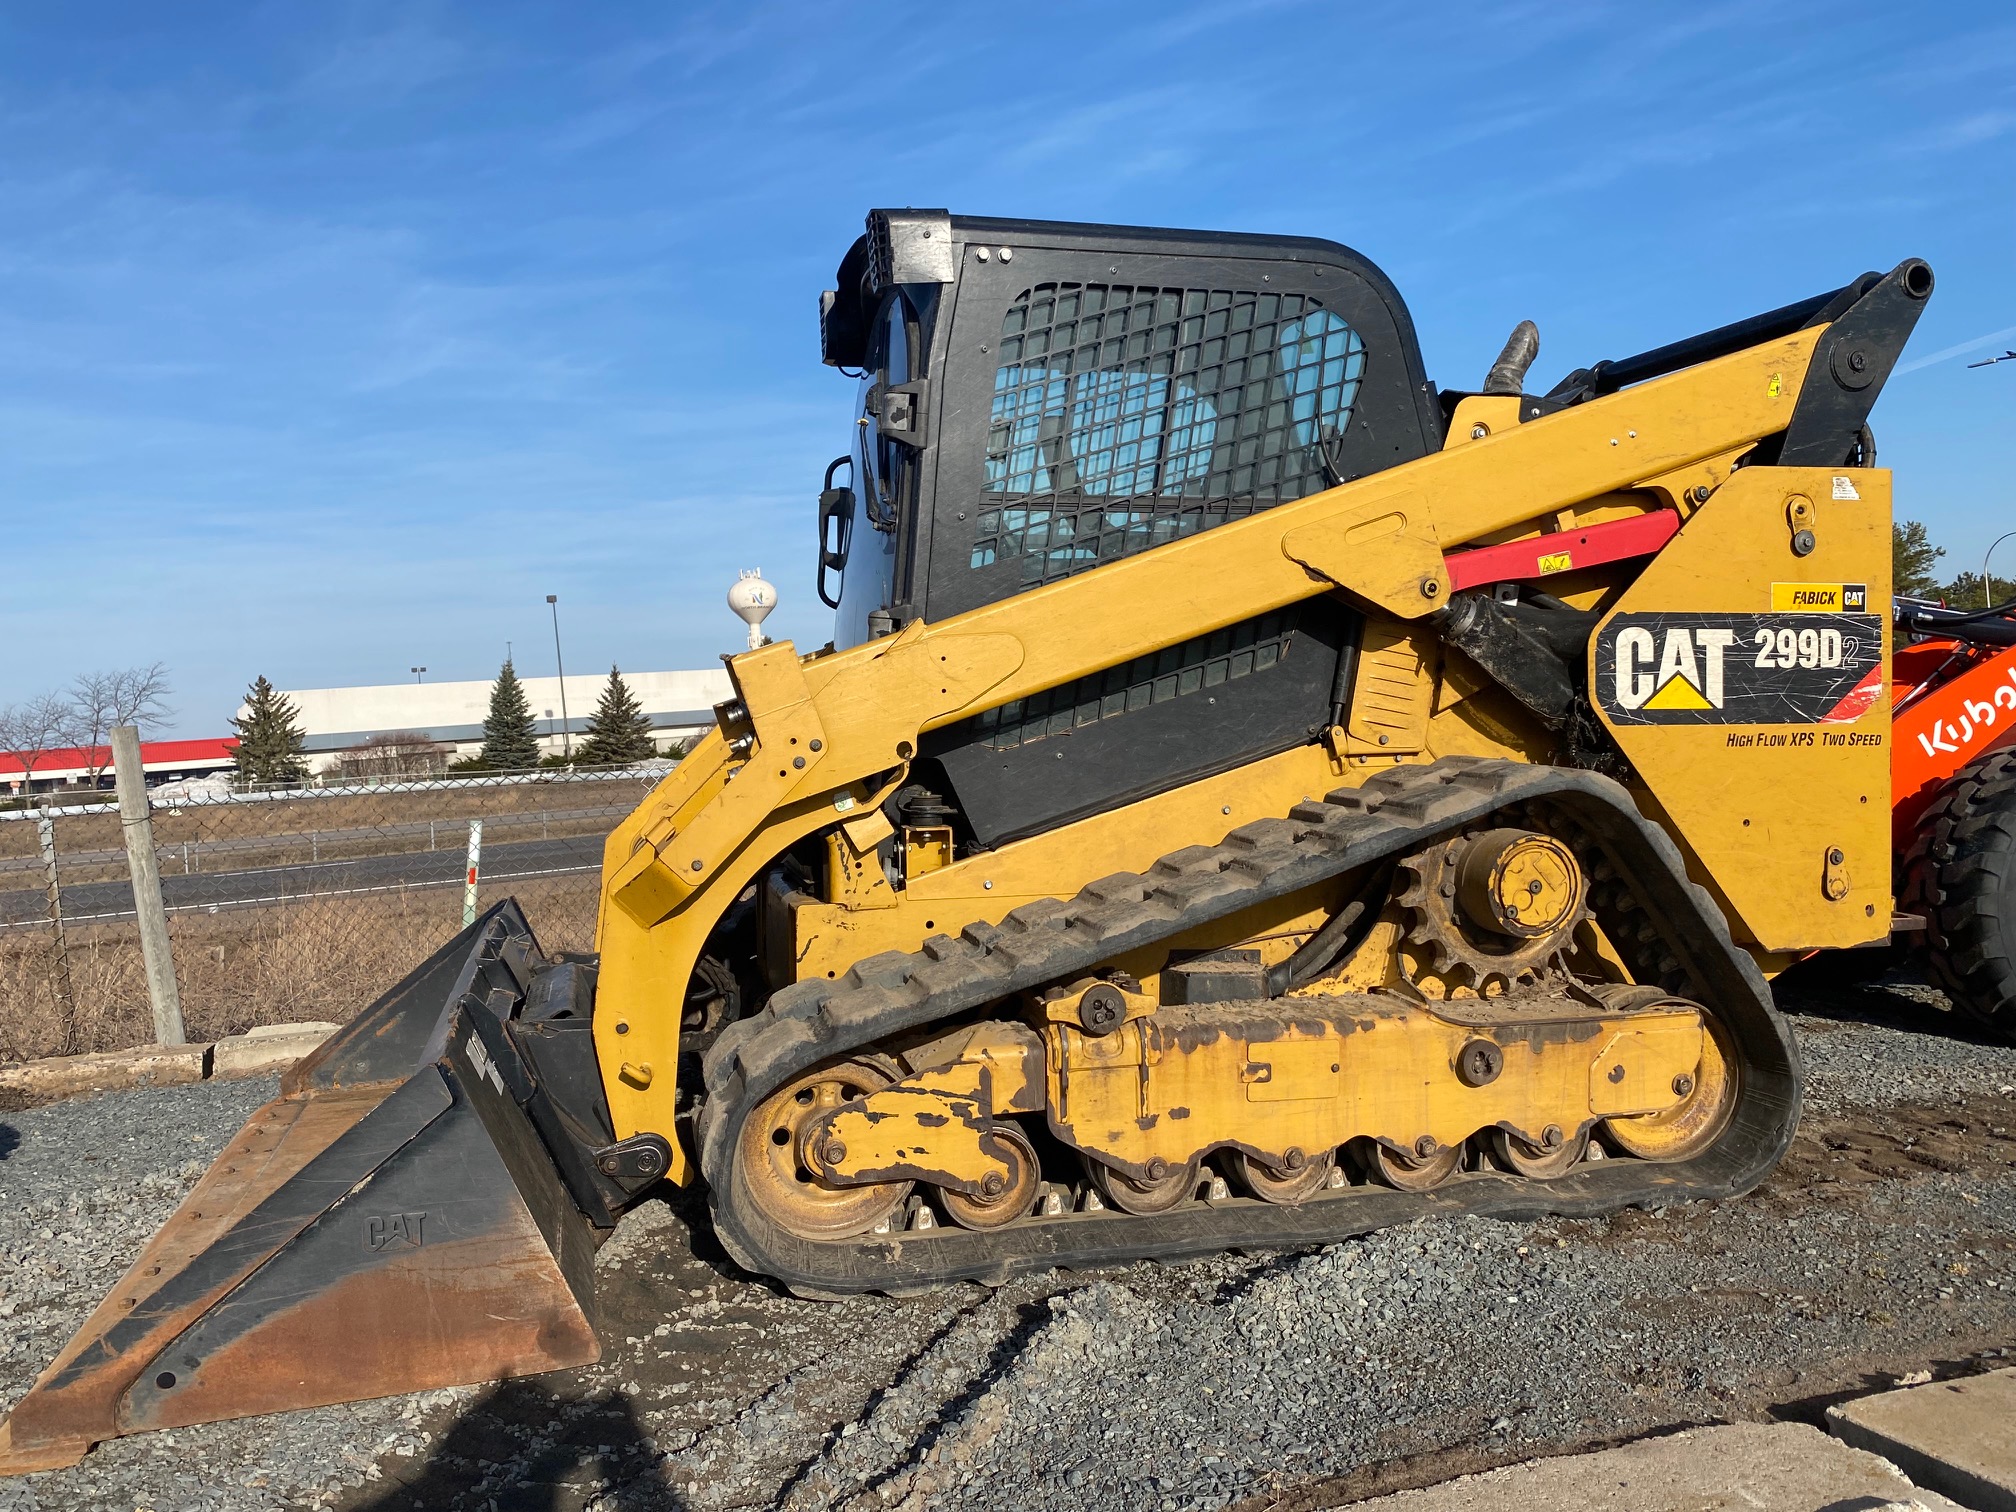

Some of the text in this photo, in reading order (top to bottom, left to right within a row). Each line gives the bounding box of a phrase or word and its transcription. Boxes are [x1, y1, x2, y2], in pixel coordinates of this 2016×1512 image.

[1792, 591, 1864, 606] FABICK CAT
[1615, 626, 1734, 710] CAT
[1789, 732, 1815, 747] XPS
[362, 1211, 427, 1253] CAT
